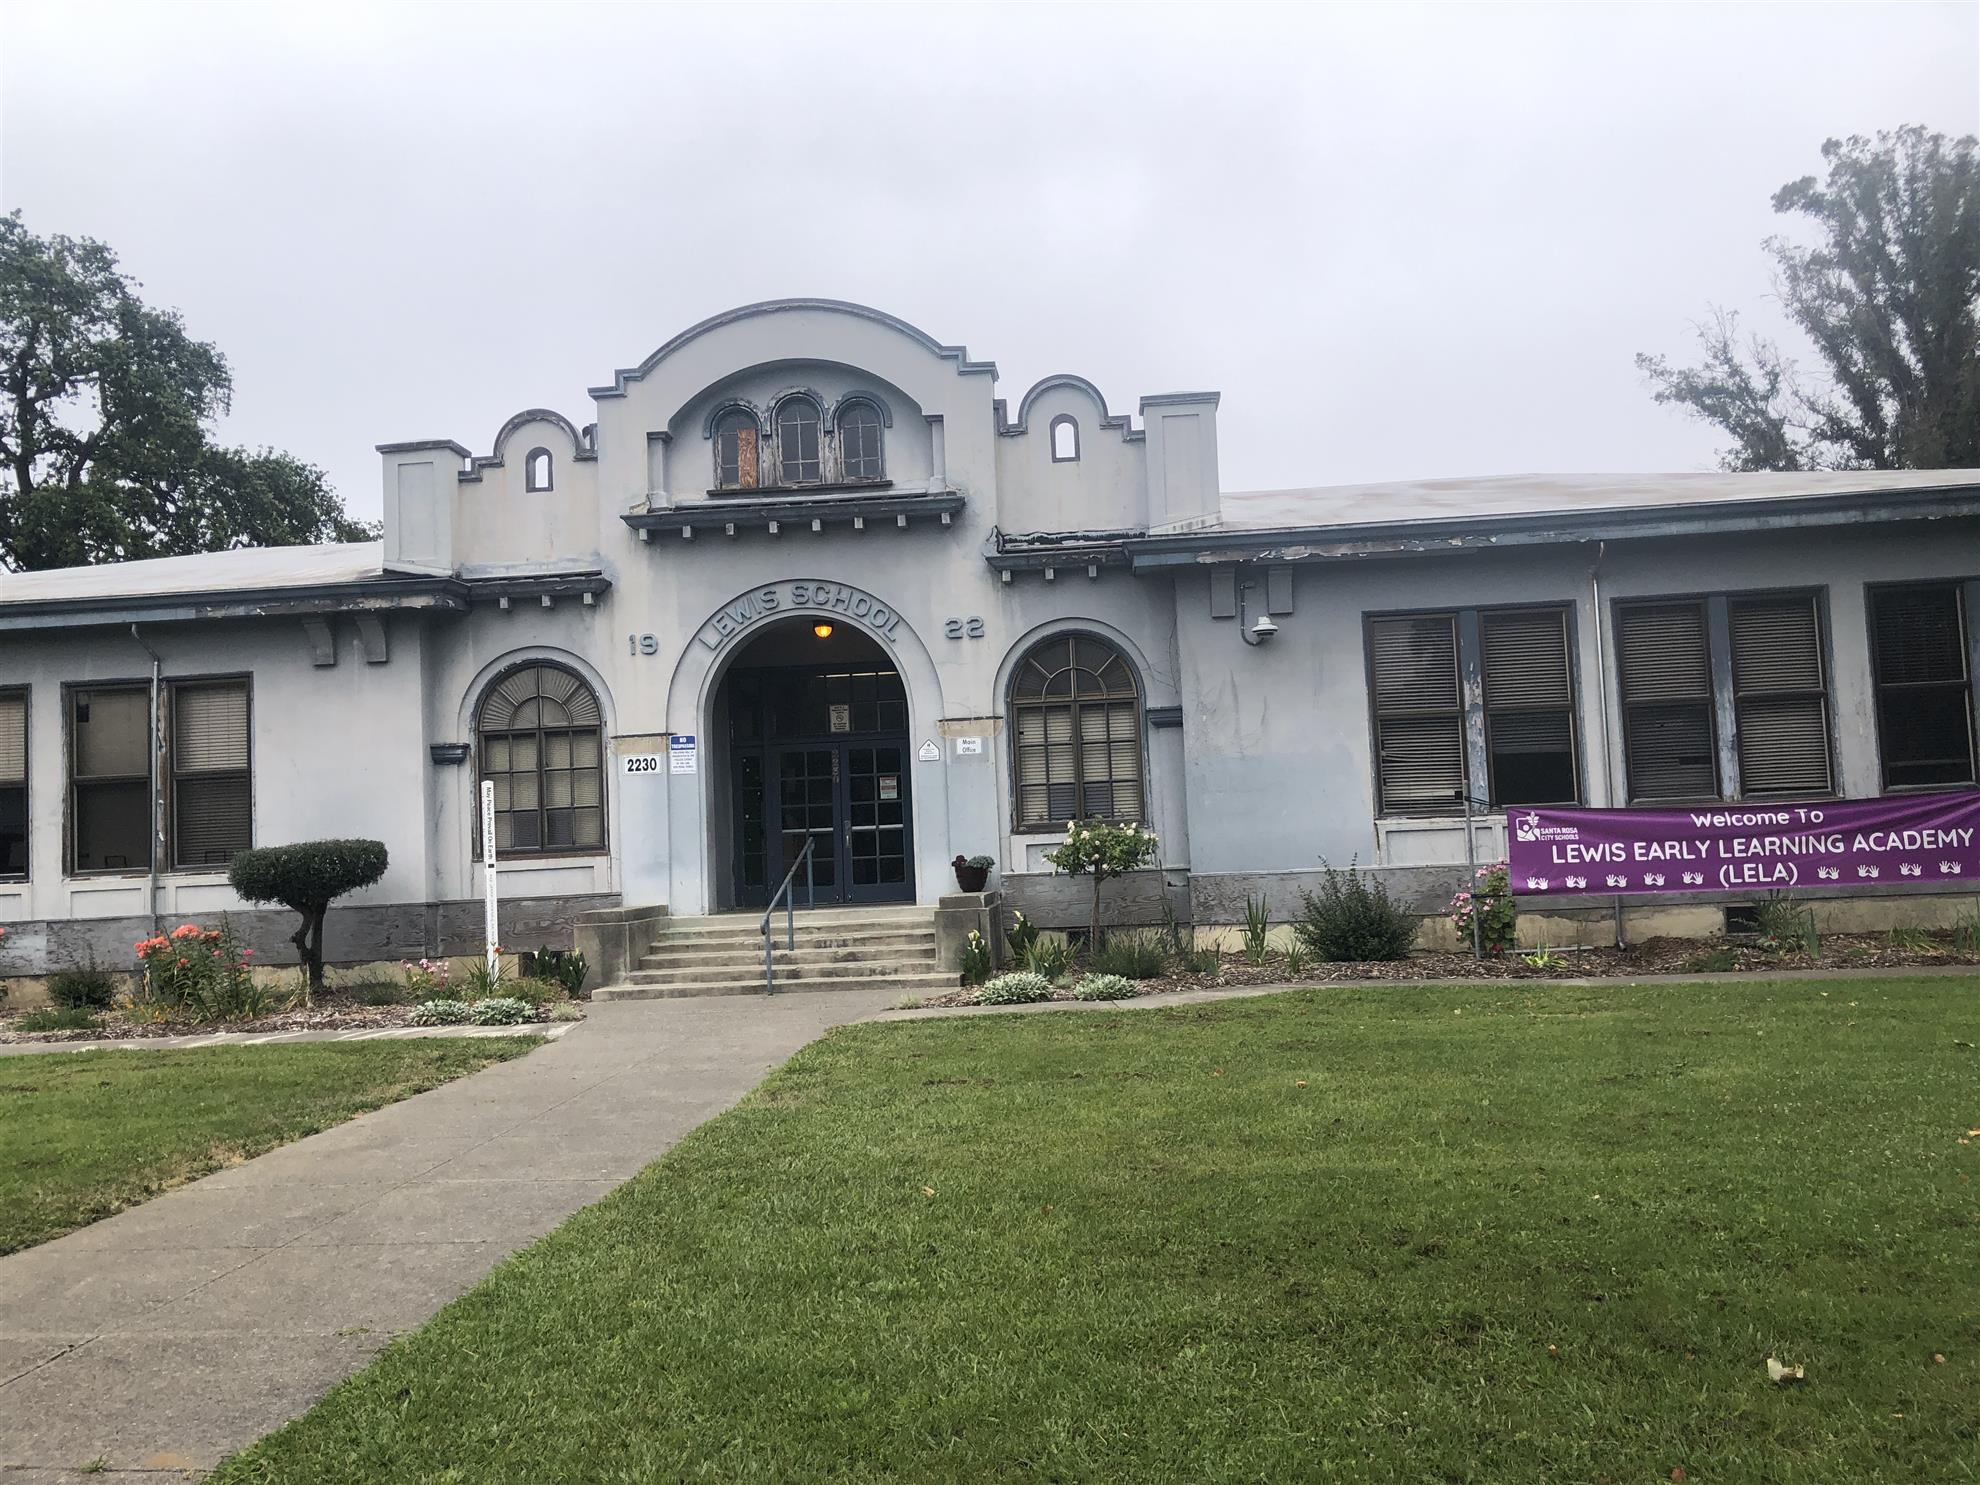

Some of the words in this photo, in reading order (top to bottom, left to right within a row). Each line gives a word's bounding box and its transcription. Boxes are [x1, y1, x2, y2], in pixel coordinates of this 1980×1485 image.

[699, 588, 780, 650] LEWIS
[791, 583, 901, 643] SCHOOL
[944, 616, 985, 640] 22
[628, 633, 659, 656] 19
[627, 757, 657, 772] 2230
[1690, 811, 1790, 828] Welcome
[1795, 808, 1824, 824] To
[487, 836, 494, 844] On
[1541, 827, 1561, 835] SANTA
[1552, 843, 1626, 864] LEWIS
[1633, 840, 1710, 861] EARLY
[1719, 834, 1845, 858] LEARNING
[1852, 828, 1974, 852] ACADEMY
[1719, 862, 1798, 887] (LELA)
